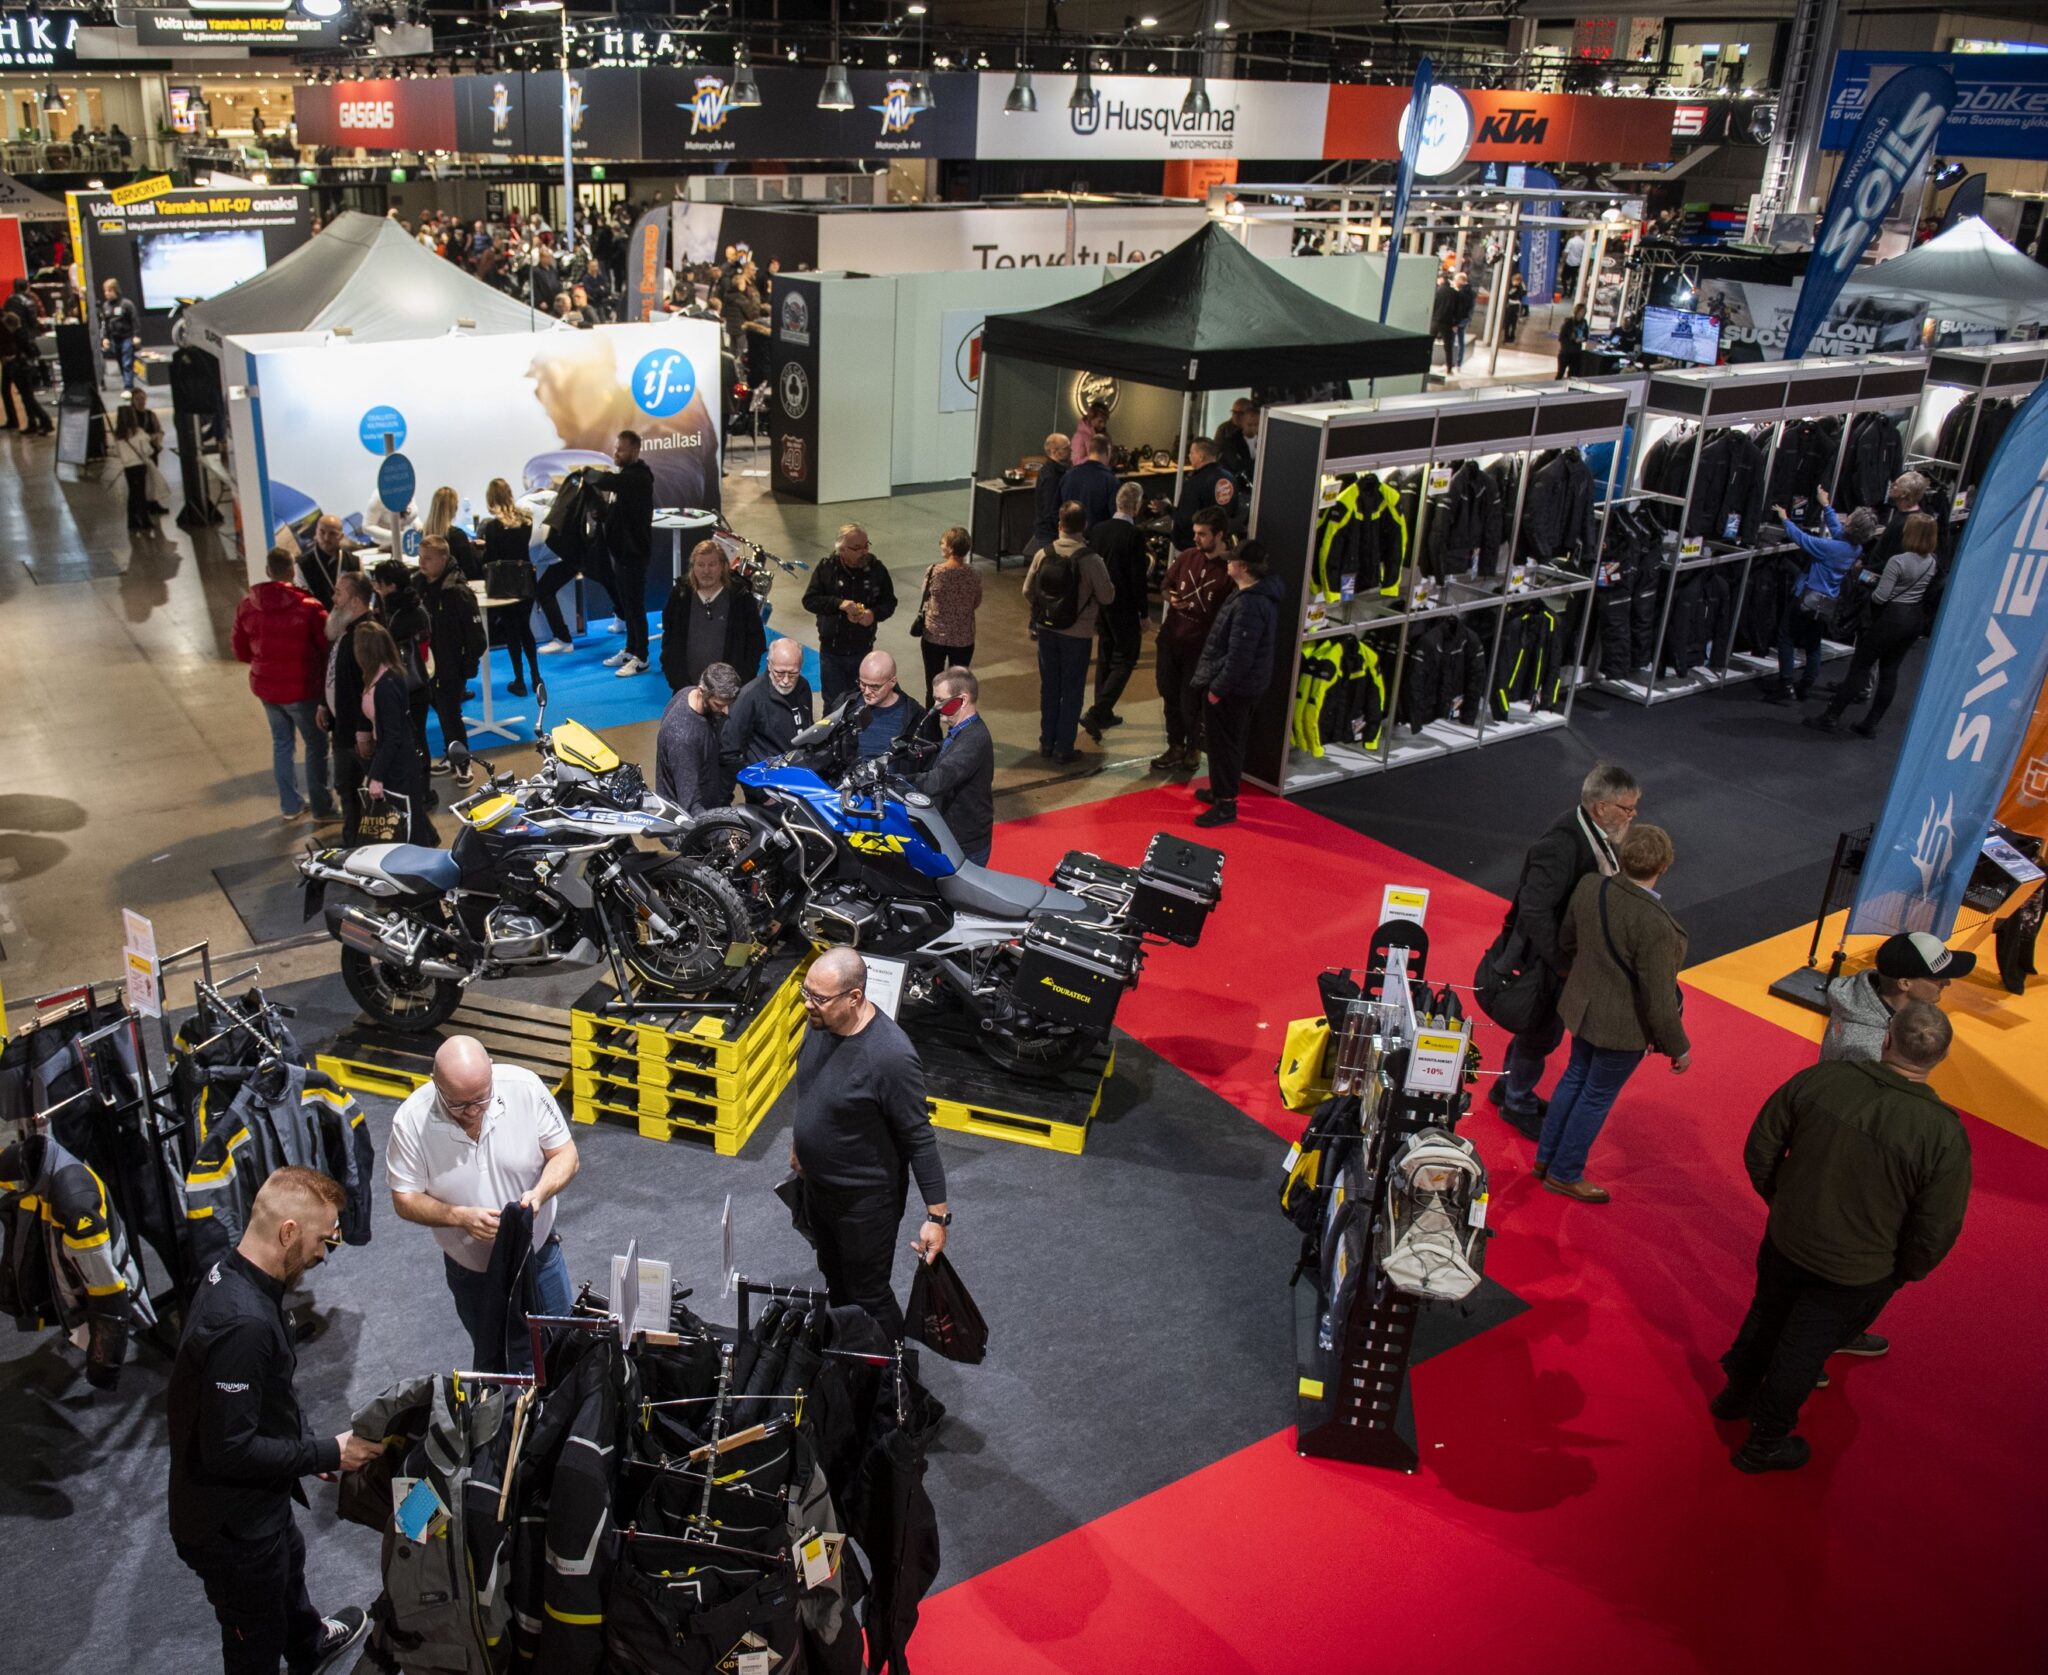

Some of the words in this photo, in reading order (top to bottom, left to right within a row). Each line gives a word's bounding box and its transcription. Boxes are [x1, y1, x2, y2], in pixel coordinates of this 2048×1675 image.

[154, 16, 183, 30] Voita
[184, 18, 207, 30] uusi
[208, 17, 250, 31] Yamaha
[250, 18, 284, 31] MT-07
[285, 19, 322, 31] omaksi
[339, 101, 394, 129] GASGAS
[1969, 115, 2020, 126] Suomen
[1477, 108, 1549, 144] KTM
[1170, 140, 1233, 149] MOTORCYCLES
[1843, 117, 1890, 188] www.solis.fi
[1820, 91, 1946, 272] SOLIS
[90, 201, 125, 216] Voita
[127, 200, 155, 215] uusi
[156, 198, 209, 214] Yamaha
[209, 197, 251, 213] MT-07
[252, 197, 298, 211] omaksi
[592, 813, 620, 823] GS
[622, 814, 655, 826] TROPHY
[1052, 984, 1092, 1004] TOURATECH
[1422, 1067, 1444, 1076] -10%
[216, 1382, 249, 1392] TRIUMPH
